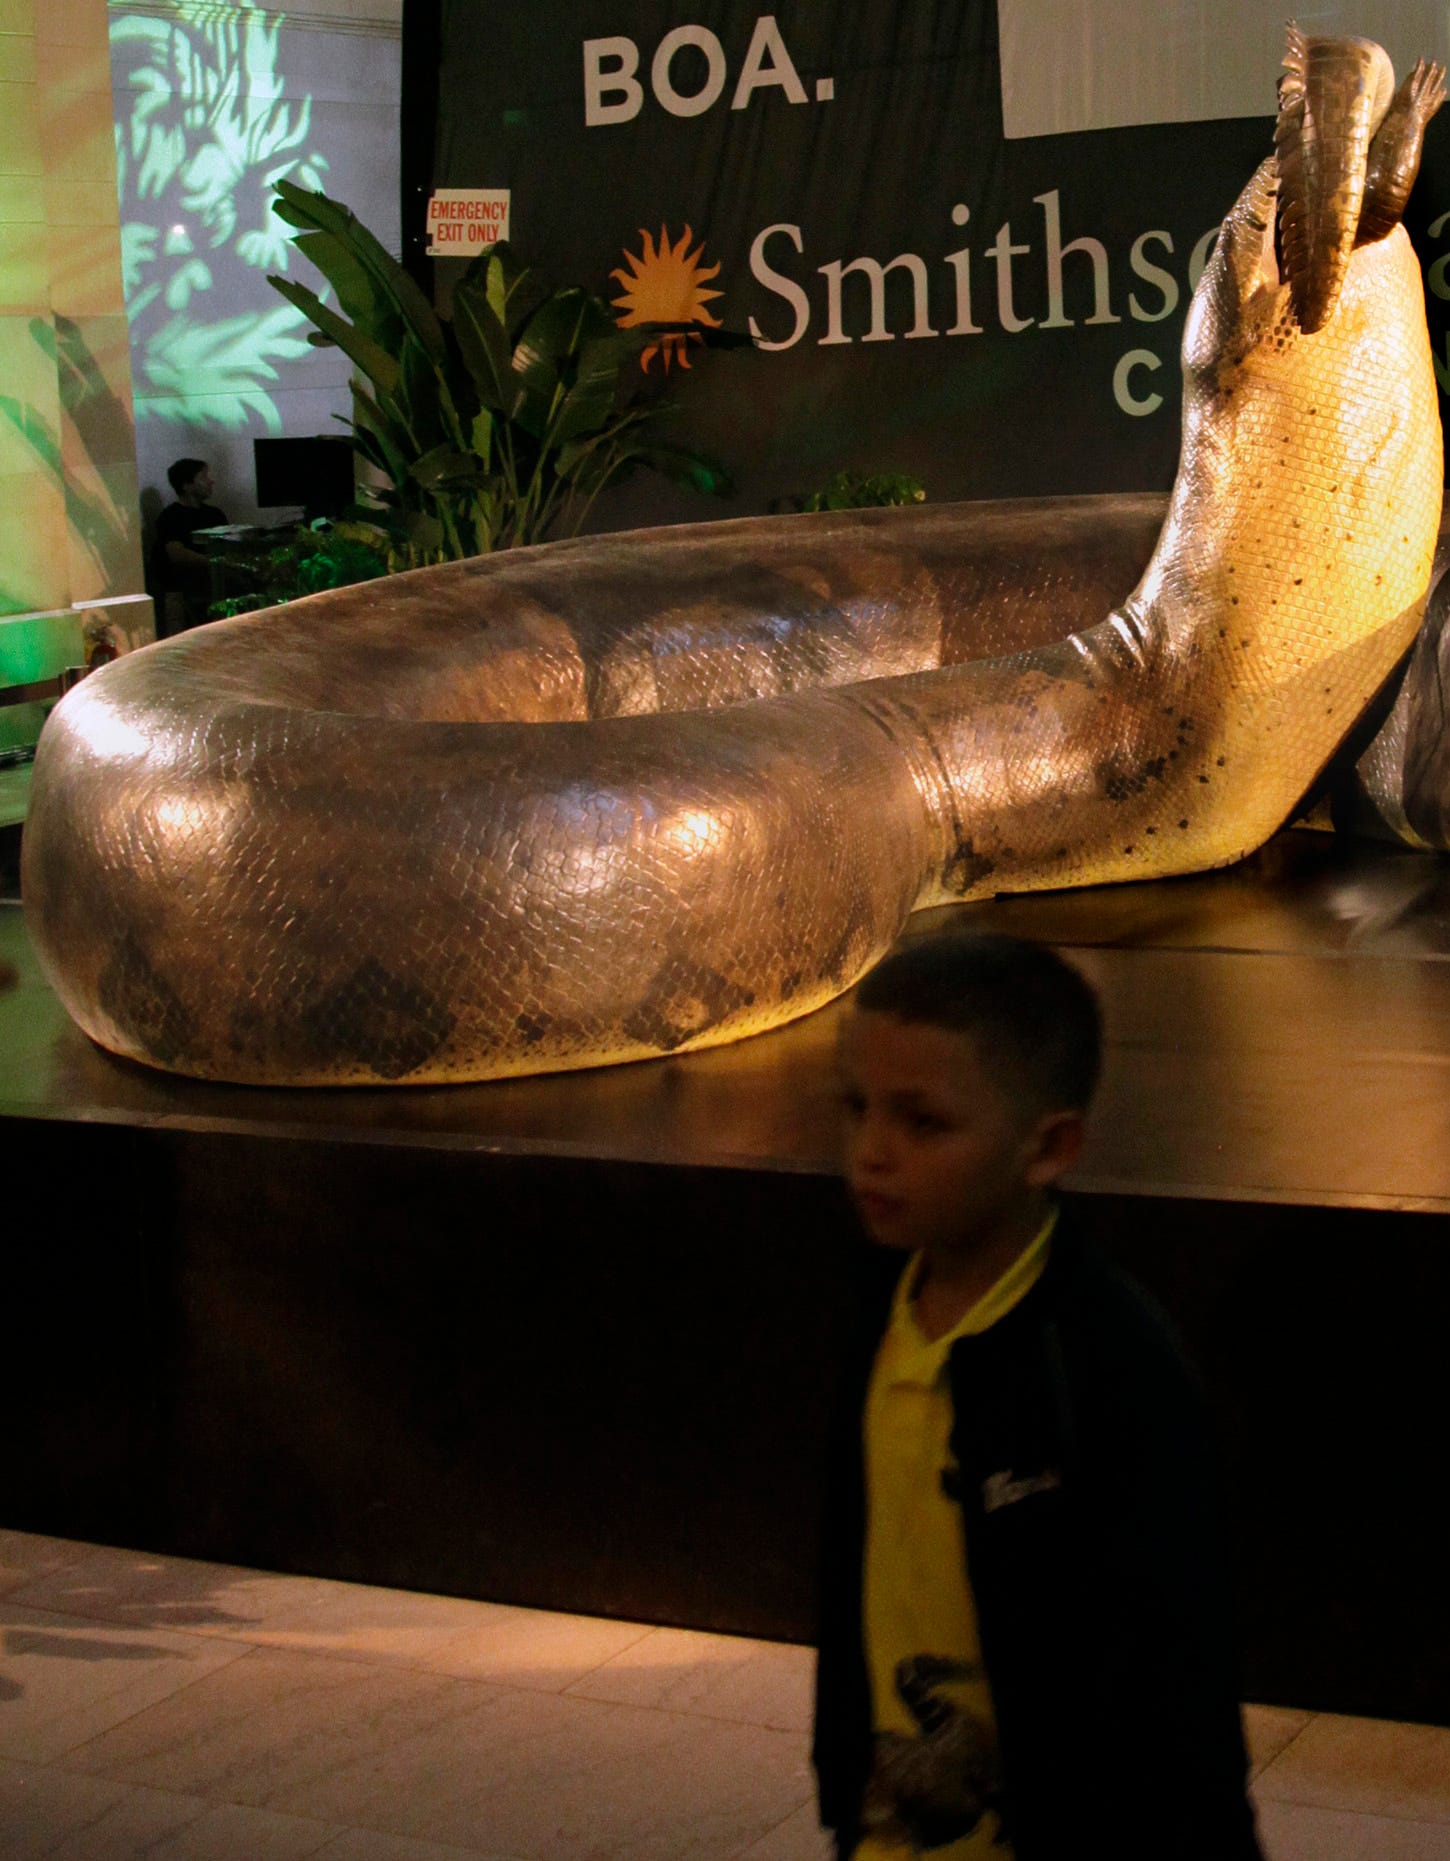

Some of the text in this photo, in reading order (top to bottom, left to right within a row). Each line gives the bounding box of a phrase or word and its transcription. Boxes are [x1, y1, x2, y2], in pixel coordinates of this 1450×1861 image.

[583, 15, 835, 127] BOA.
[430, 201, 508, 220] EMERGENCY
[436, 223, 500, 243] EXIT ONLY
